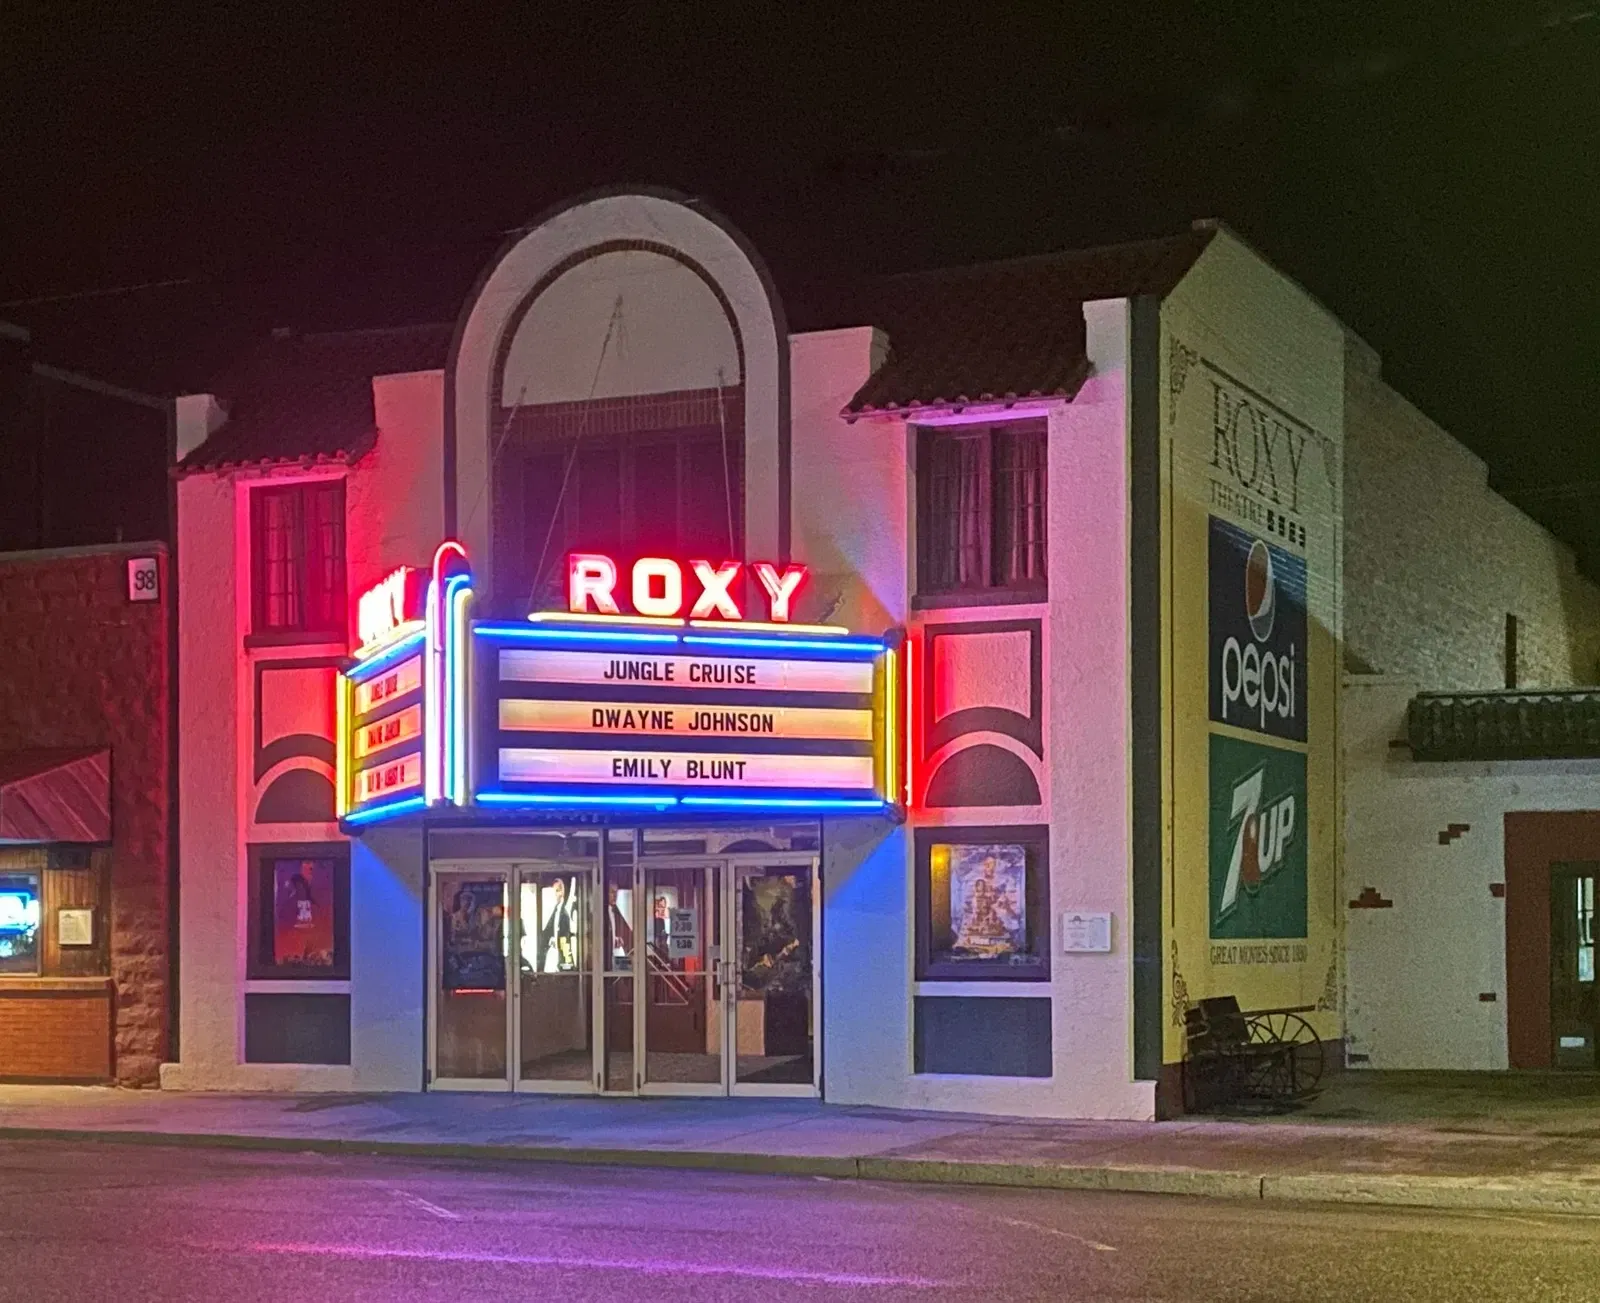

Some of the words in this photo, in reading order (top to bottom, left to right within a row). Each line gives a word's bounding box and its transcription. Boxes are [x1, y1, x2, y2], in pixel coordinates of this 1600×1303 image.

[1208, 379, 1306, 515] ROXY
[135, 570, 156, 591] 98
[569, 553, 808, 622] ROXY
[604, 660, 675, 682] JUNGLE
[689, 663, 757, 685] CRUISE
[1222, 636, 1295, 730] pepsi
[592, 708, 674, 730] DWAYNE
[688, 711, 774, 733] JOHNSON
[612, 758, 672, 778] EMILY
[686, 760, 747, 780] BLUNT
[1209, 945, 1238, 965] GREAT
